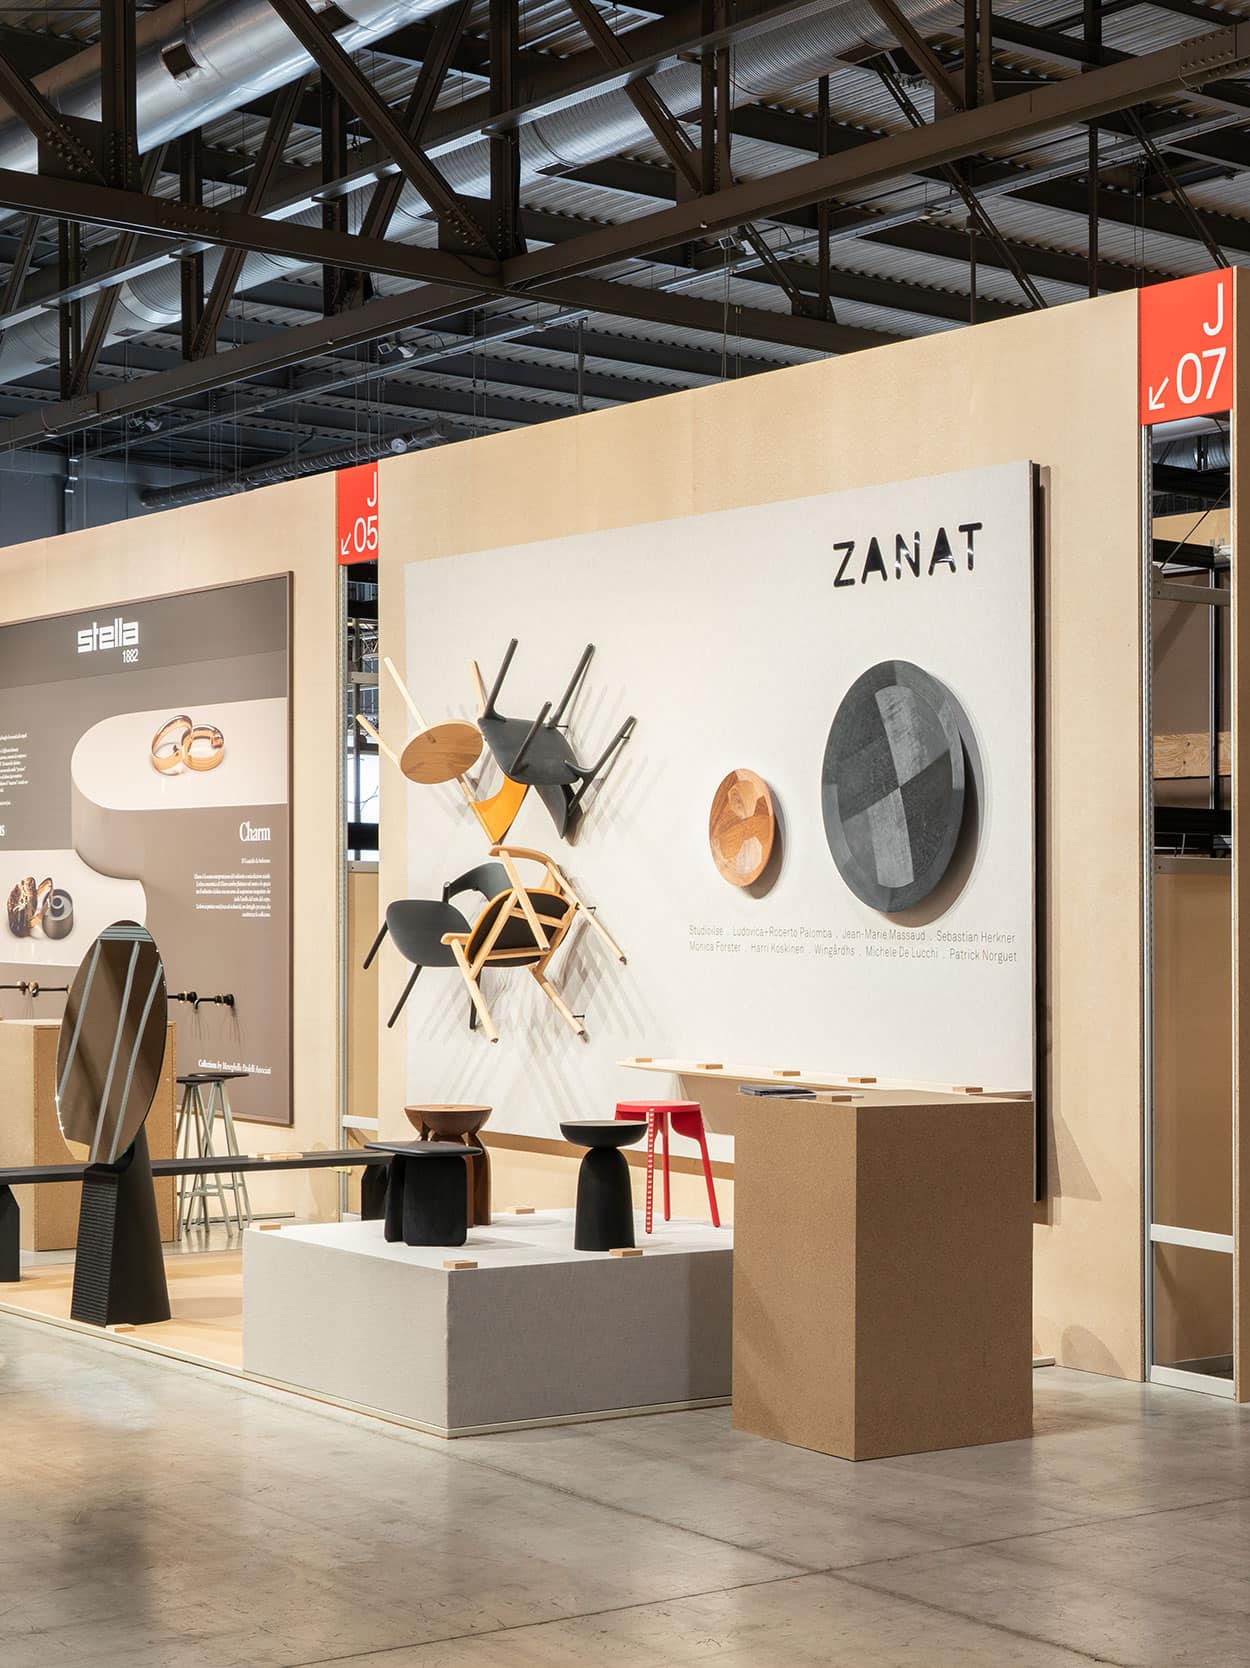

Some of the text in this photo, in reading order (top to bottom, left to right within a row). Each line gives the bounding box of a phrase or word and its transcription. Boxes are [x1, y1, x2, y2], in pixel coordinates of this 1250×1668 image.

[1203, 283, 1224, 336] J
[1177, 346, 1226, 404] 07
[366, 471, 377, 507] J
[354, 515, 378, 552] 05
[833, 522, 983, 588] ZANAT
[78, 617, 139, 653] stella
[122, 648, 139, 663] 1882
[239, 820, 271, 842] Charm
[841, 929, 887, 941] Jean-Marie
[889, 930, 926, 941] Massaud
[936, 930, 979, 943] Sebastian
[980, 931, 1016, 944] Herkner
[865, 946, 897, 958] Michele
[949, 948, 980, 960] Patrick
[982, 949, 1017, 964] Norguet
